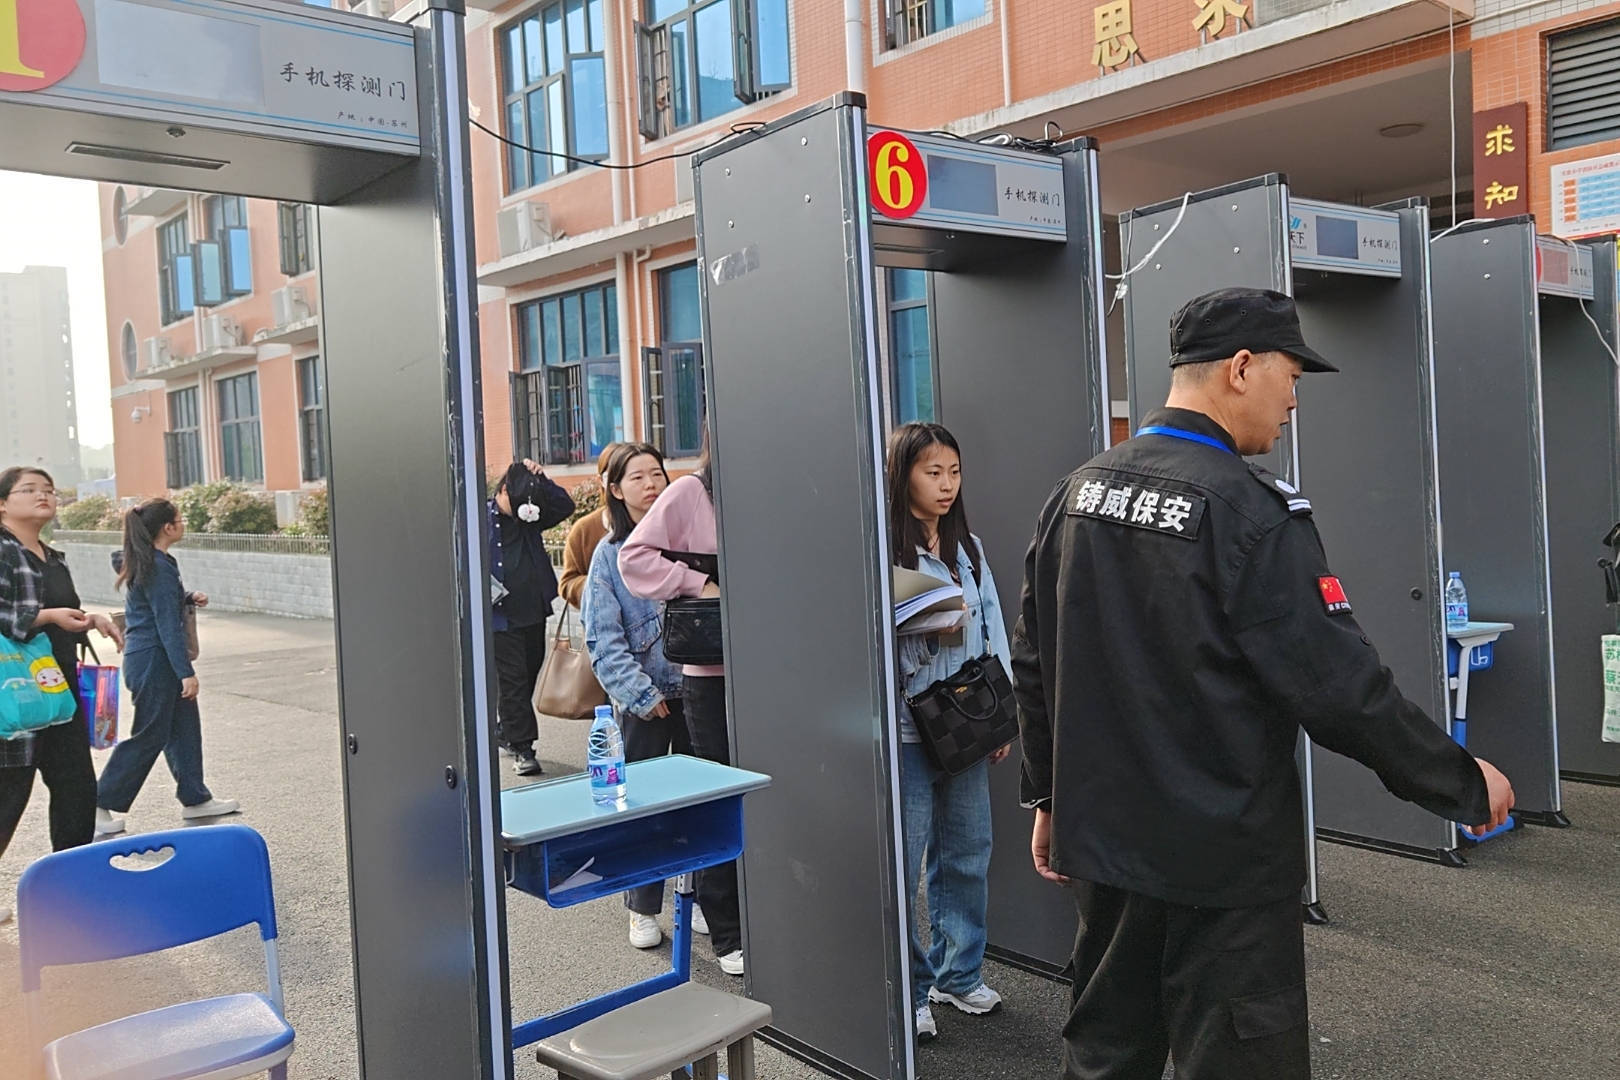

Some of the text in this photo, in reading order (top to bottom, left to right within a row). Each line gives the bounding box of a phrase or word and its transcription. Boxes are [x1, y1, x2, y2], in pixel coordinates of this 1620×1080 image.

[280, 62, 406, 101] 手机探测门
[875, 140, 914, 210] 6
[1484, 124, 1519, 210] 求知
[1004, 186, 1060, 207] 手机探测门
[1076, 480, 1192, 532] 铸威保安
